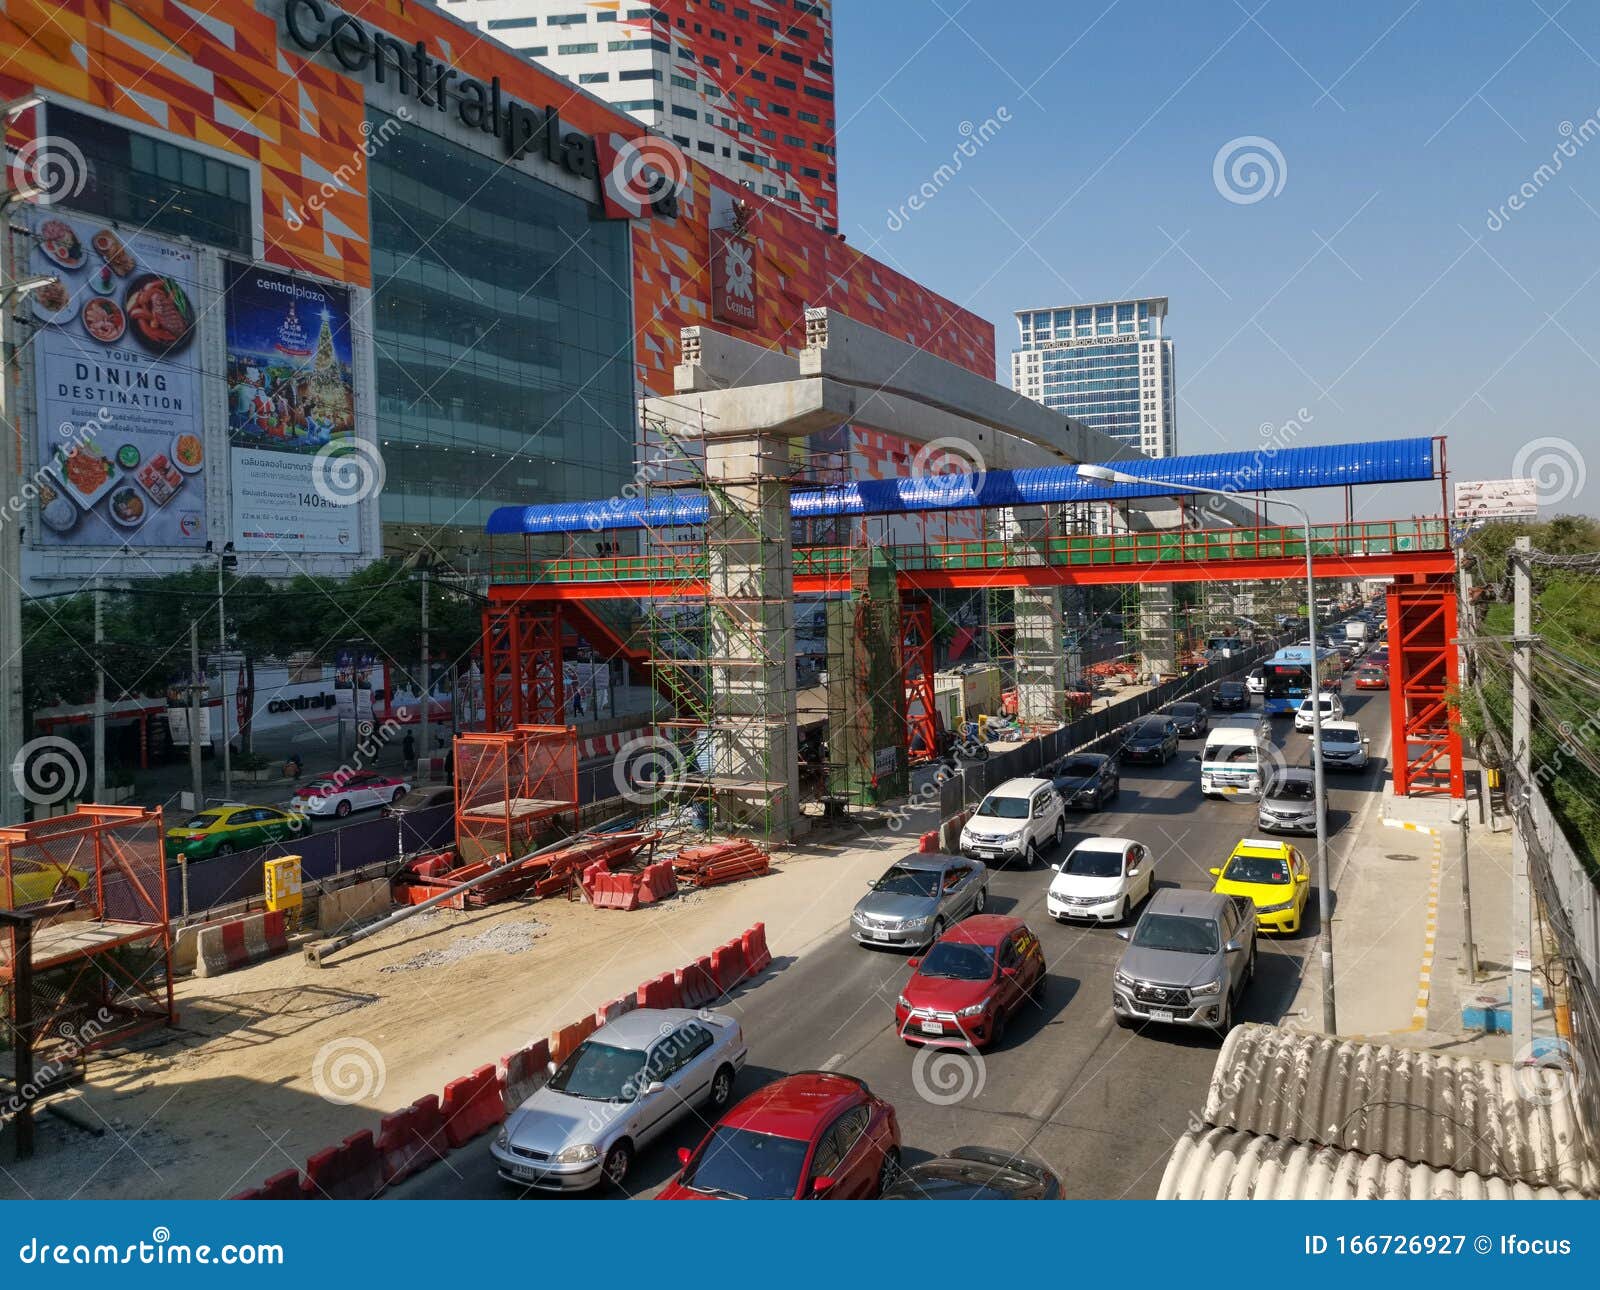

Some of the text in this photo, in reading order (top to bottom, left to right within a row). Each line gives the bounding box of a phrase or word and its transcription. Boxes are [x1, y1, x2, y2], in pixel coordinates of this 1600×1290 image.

[256, 278, 325, 302] centralplaza
[725, 296, 755, 319] Central
[1043, 335, 1139, 350] WORLD MEDICAL HOSPITAL
[105, 350, 139, 363] YOUR
[76, 363, 167, 391] DINING
[59, 384, 183, 411] DESTINATION
[298, 493, 320, 508] 140
